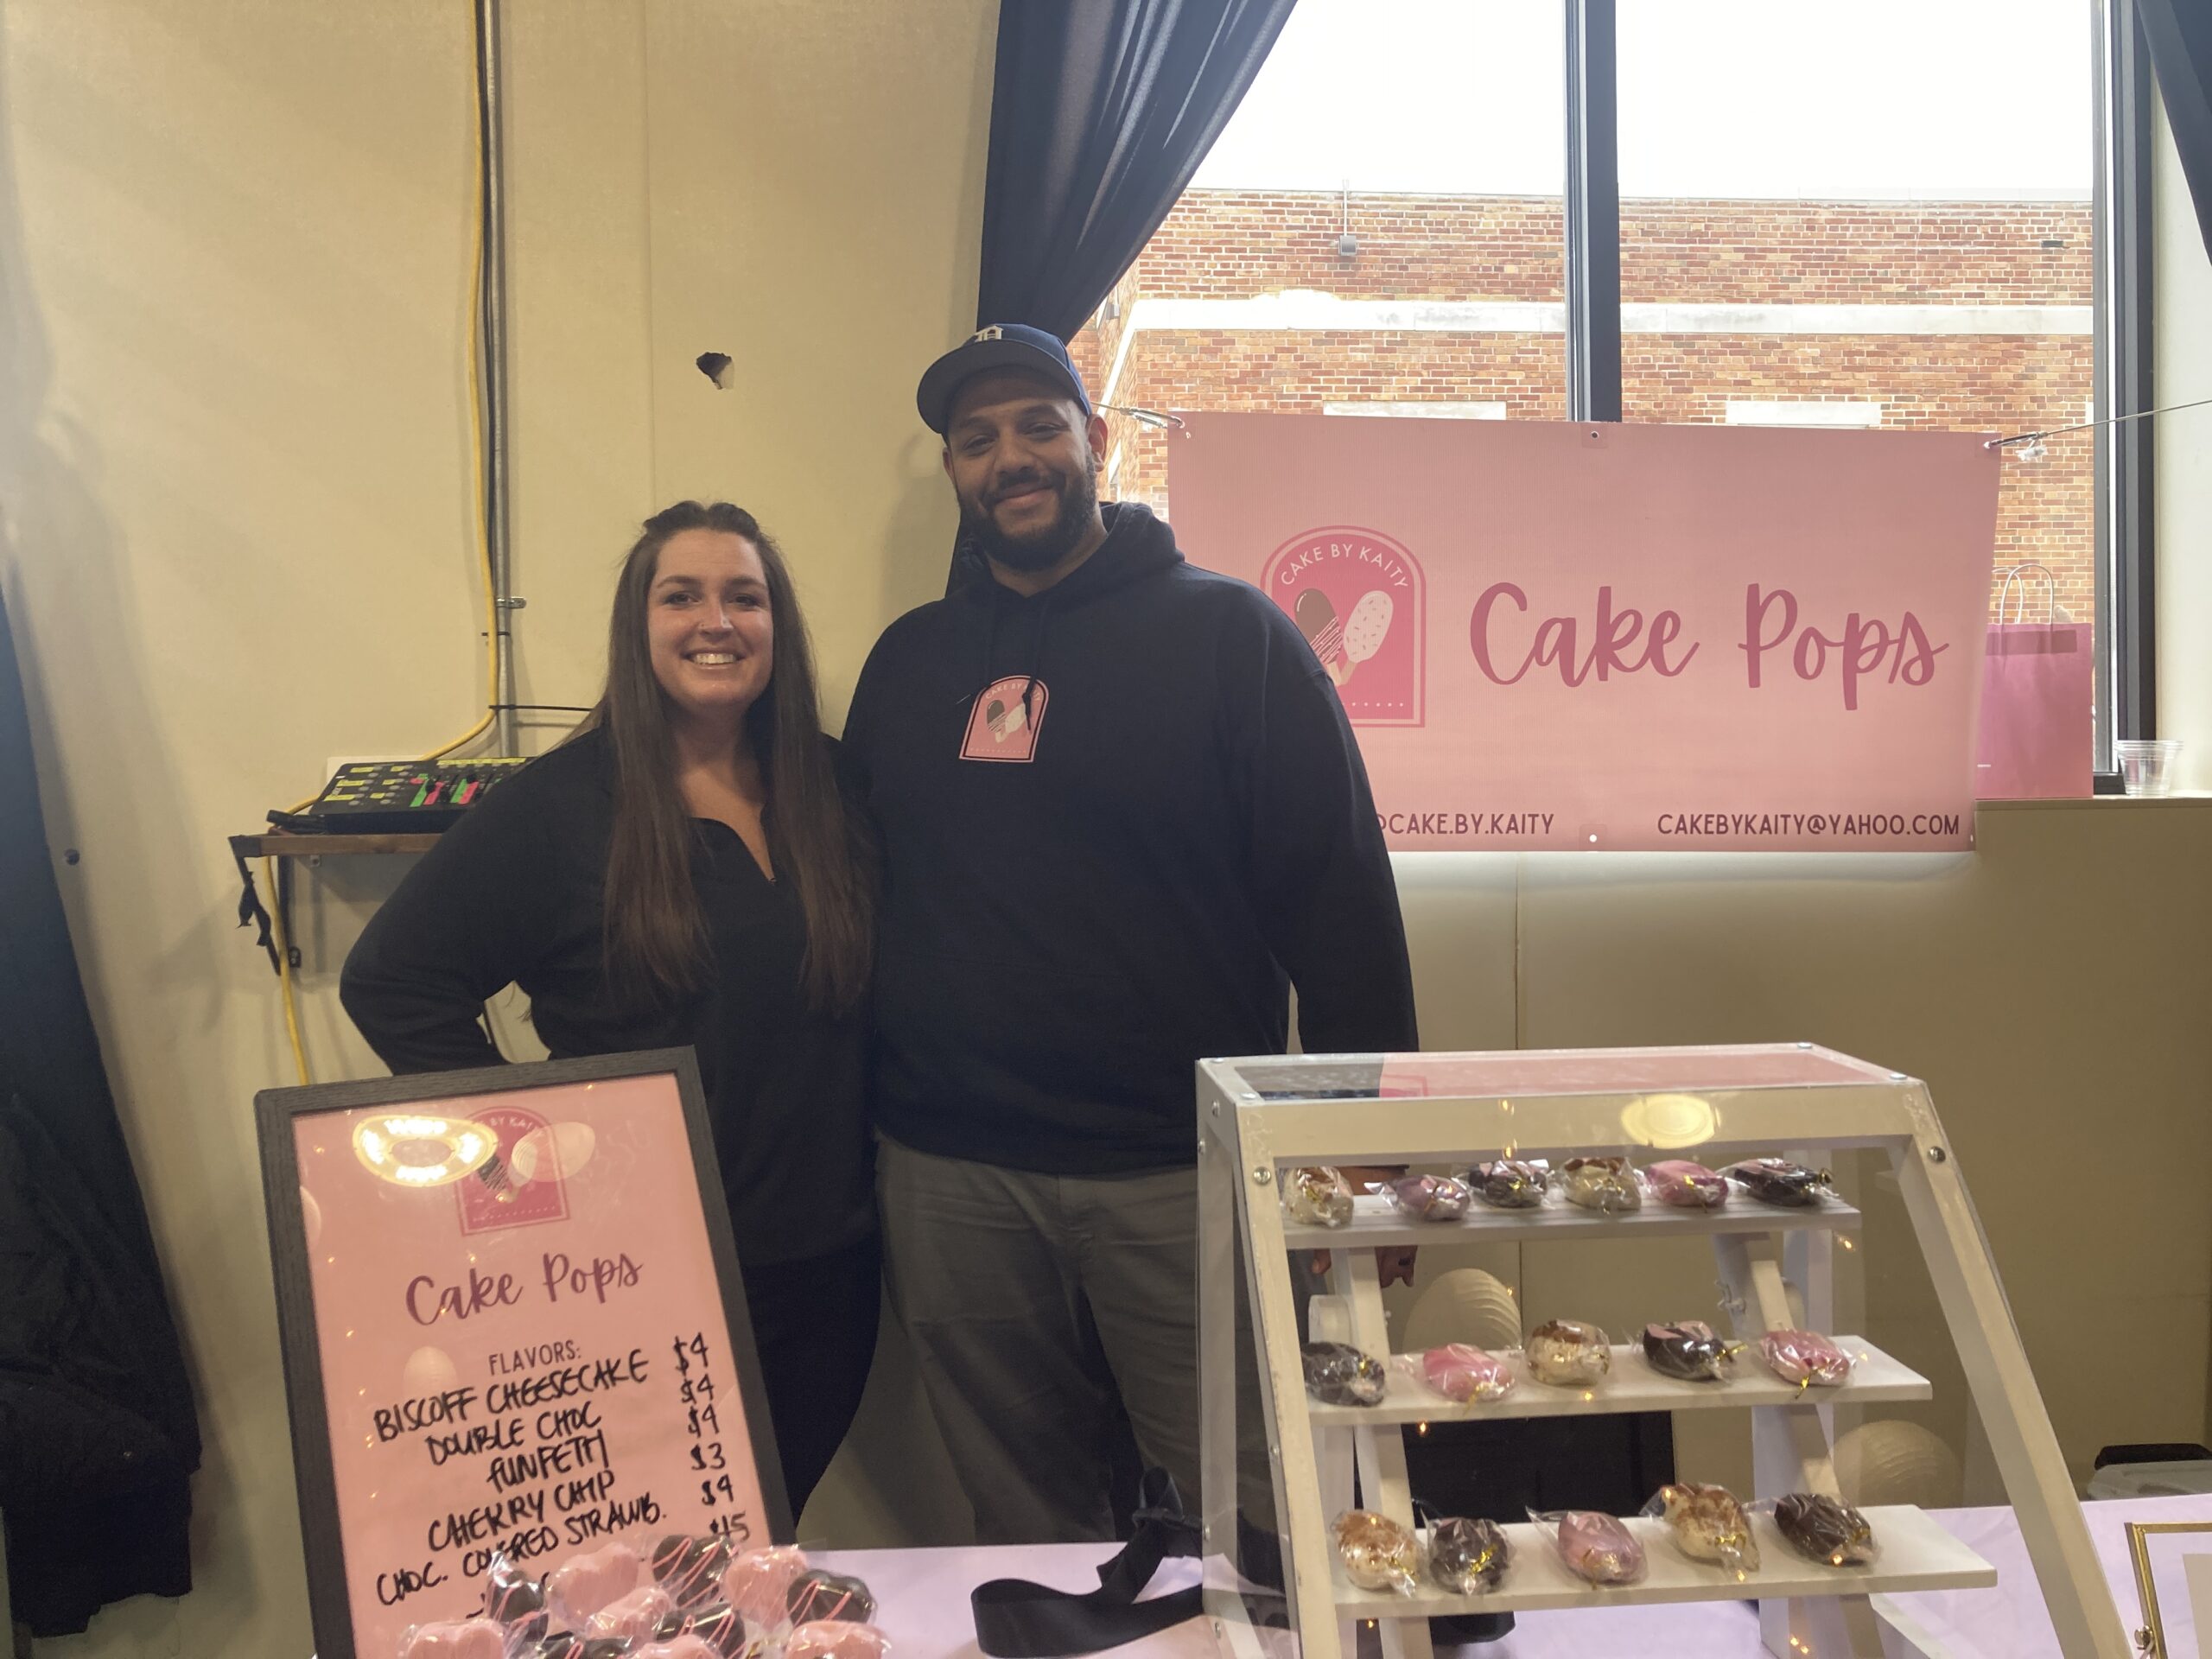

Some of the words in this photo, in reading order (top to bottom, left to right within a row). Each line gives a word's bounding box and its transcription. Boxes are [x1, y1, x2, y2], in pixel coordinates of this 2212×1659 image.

[1281, 546, 1324, 585] CAKE
[1331, 543, 1353, 558] BY
[1359, 546, 1408, 588] KAITY
[1470, 582, 1700, 688] Cake
[1738, 582, 1949, 710] Pops
[1657, 814, 1960, 836] CAKEBYKAITY@YAHOO.COM
[406, 1268, 524, 1325] Cake
[543, 1252, 644, 1304] Pops
[373, 1386, 478, 1442] BISCOFF
[486, 1349, 649, 1414] CHEESECAKE
[674, 1332, 709, 1376] $4
[488, 1339, 582, 1376] FLAVORS:
[424, 1418, 524, 1465] DOUBLE
[537, 1400, 602, 1440] CHOC
[681, 1373, 714, 1404] $4
[688, 1403, 720, 1439] $4
[429, 1489, 543, 1552] CHERRY
[554, 1470, 614, 1511] CHIP
[690, 1442, 726, 1471] $3
[377, 1560, 448, 1605] CHOC.
[702, 1473, 734, 1506] $4
